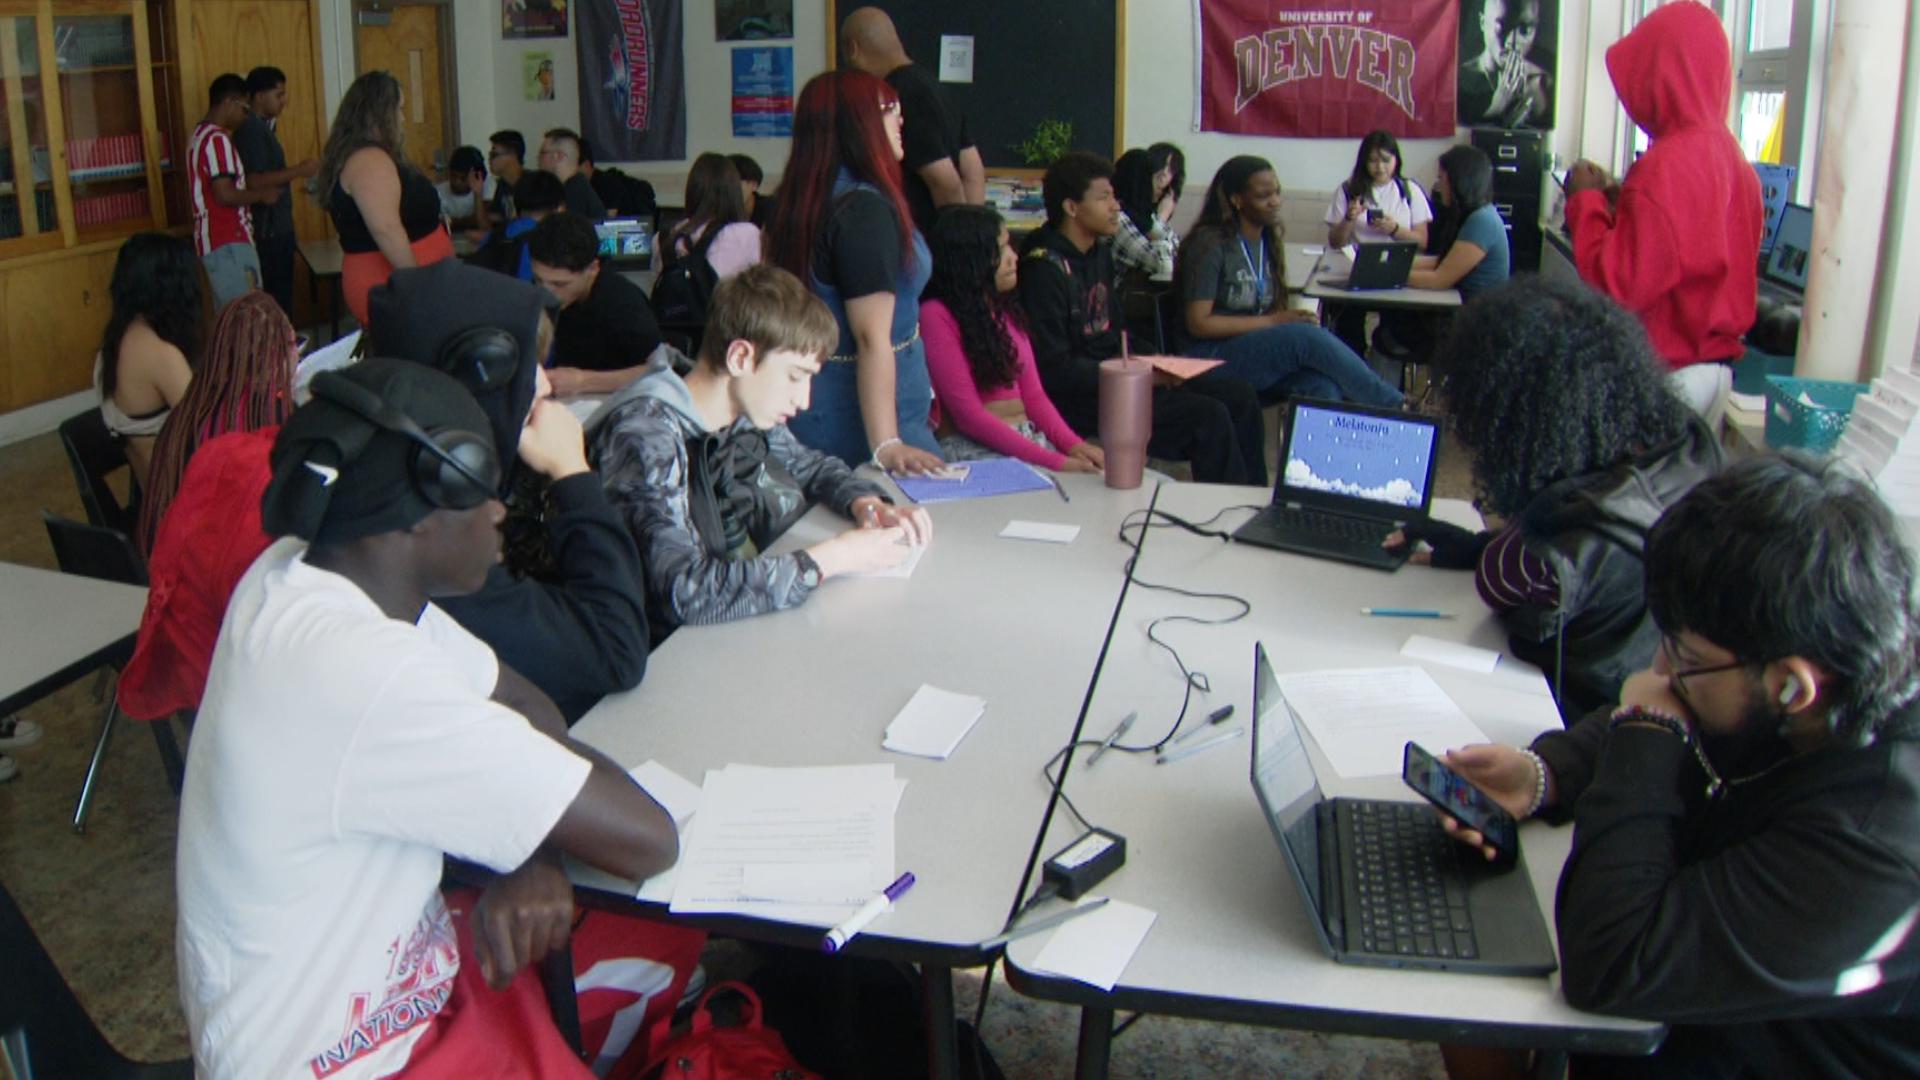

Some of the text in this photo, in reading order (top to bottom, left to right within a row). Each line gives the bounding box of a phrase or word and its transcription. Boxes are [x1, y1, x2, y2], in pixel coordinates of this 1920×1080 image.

[1279, 11, 1374, 23] UNIVERSITY OF
[1234, 25, 1416, 119] DENVER
